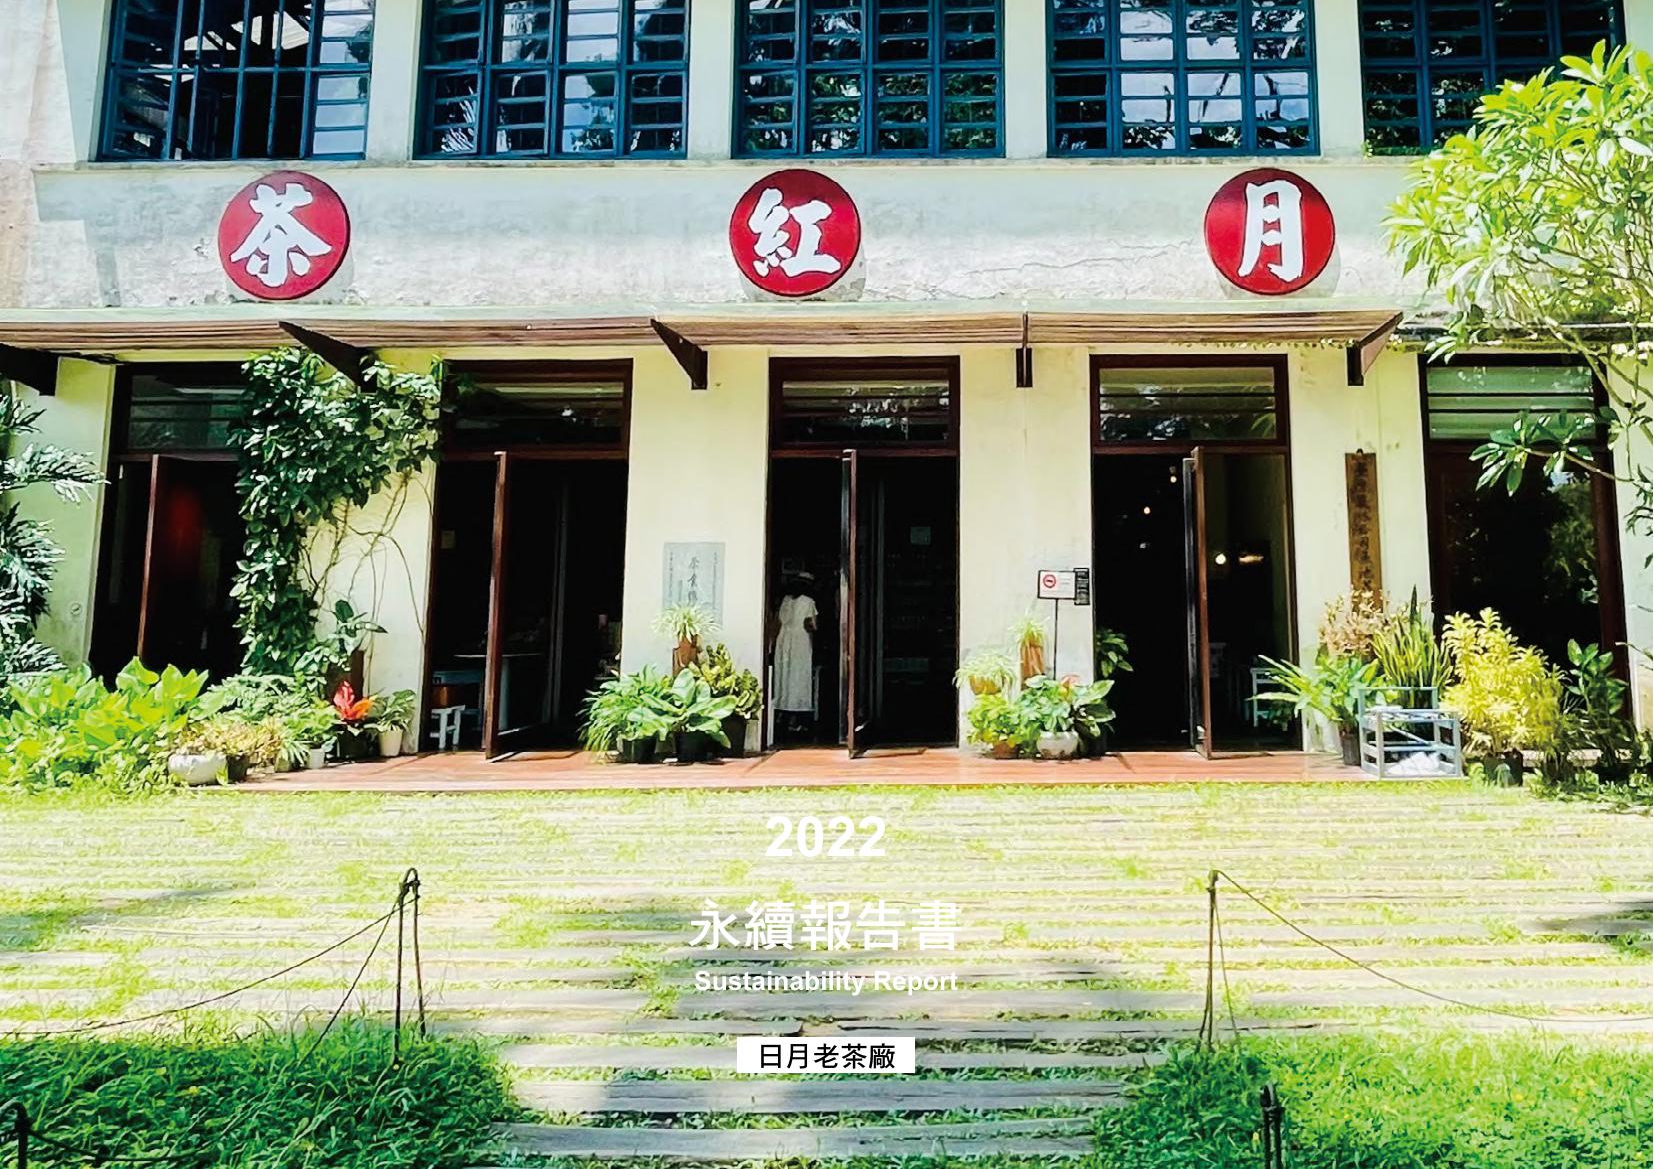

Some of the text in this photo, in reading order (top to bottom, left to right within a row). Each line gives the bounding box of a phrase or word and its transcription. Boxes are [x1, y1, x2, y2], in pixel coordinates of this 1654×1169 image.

[229, 179, 1305, 288] 月 紅 茶
